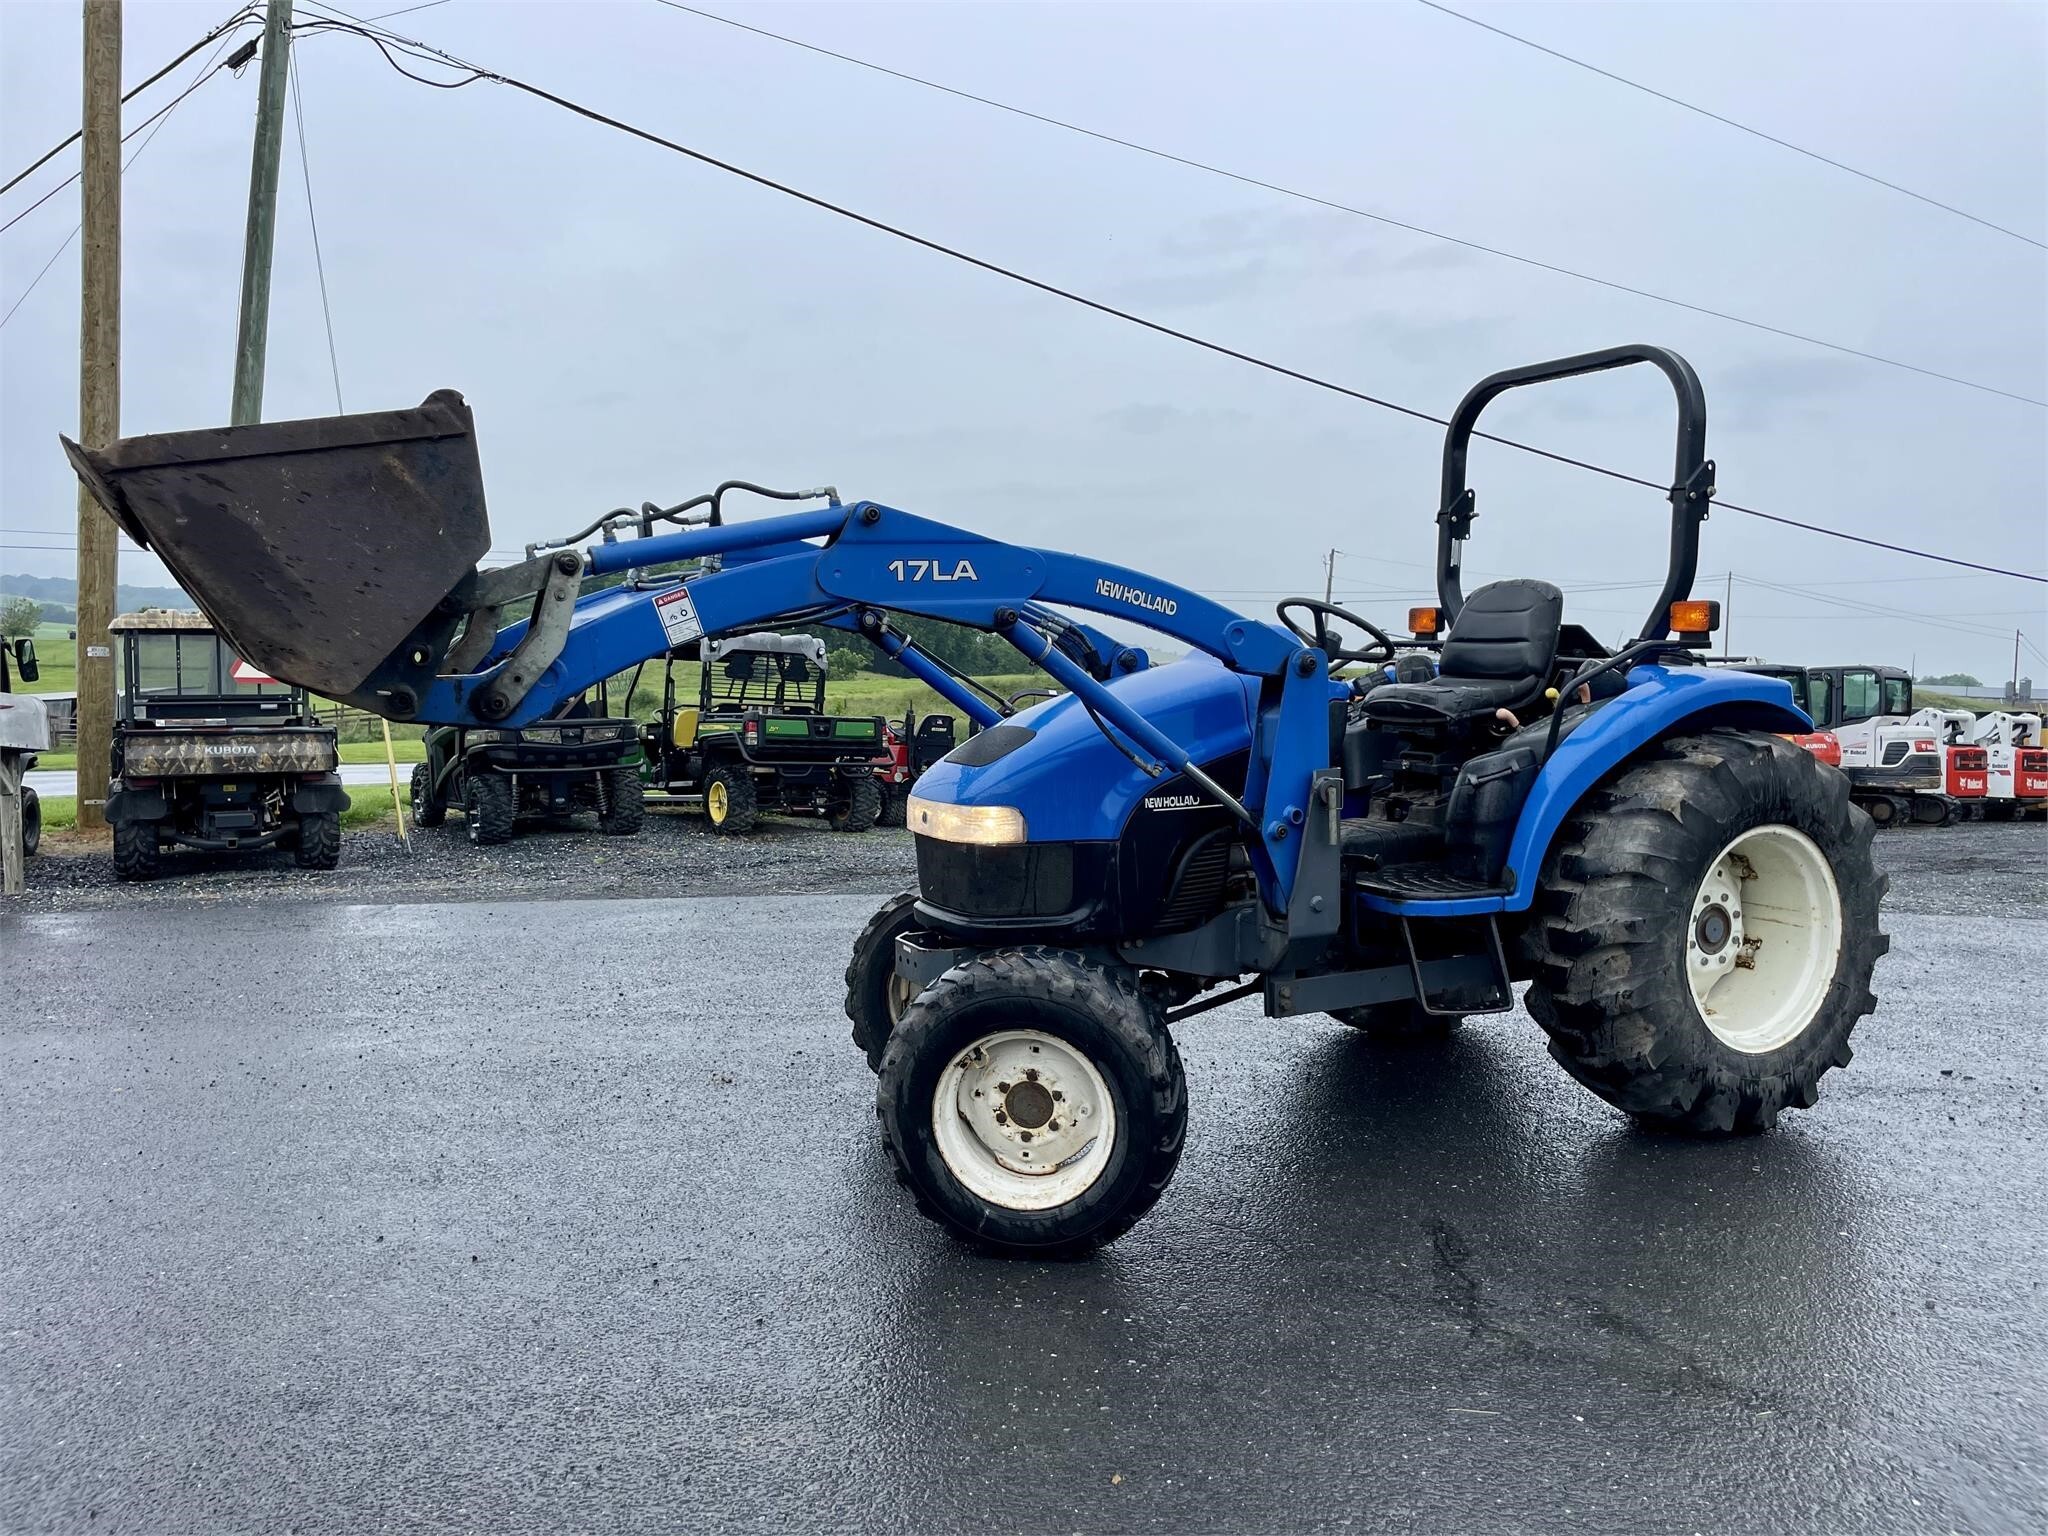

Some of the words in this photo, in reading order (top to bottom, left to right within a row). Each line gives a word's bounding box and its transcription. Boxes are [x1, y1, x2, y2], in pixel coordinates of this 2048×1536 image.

[888, 559, 979, 582] 17LA
[663, 590, 686, 602] DANGER
[1095, 578, 1124, 600] NEW
[1122, 586, 1178, 616] HOLLAND
[204, 745, 257, 755] KUBOTA
[1144, 797, 1163, 809] NEW
